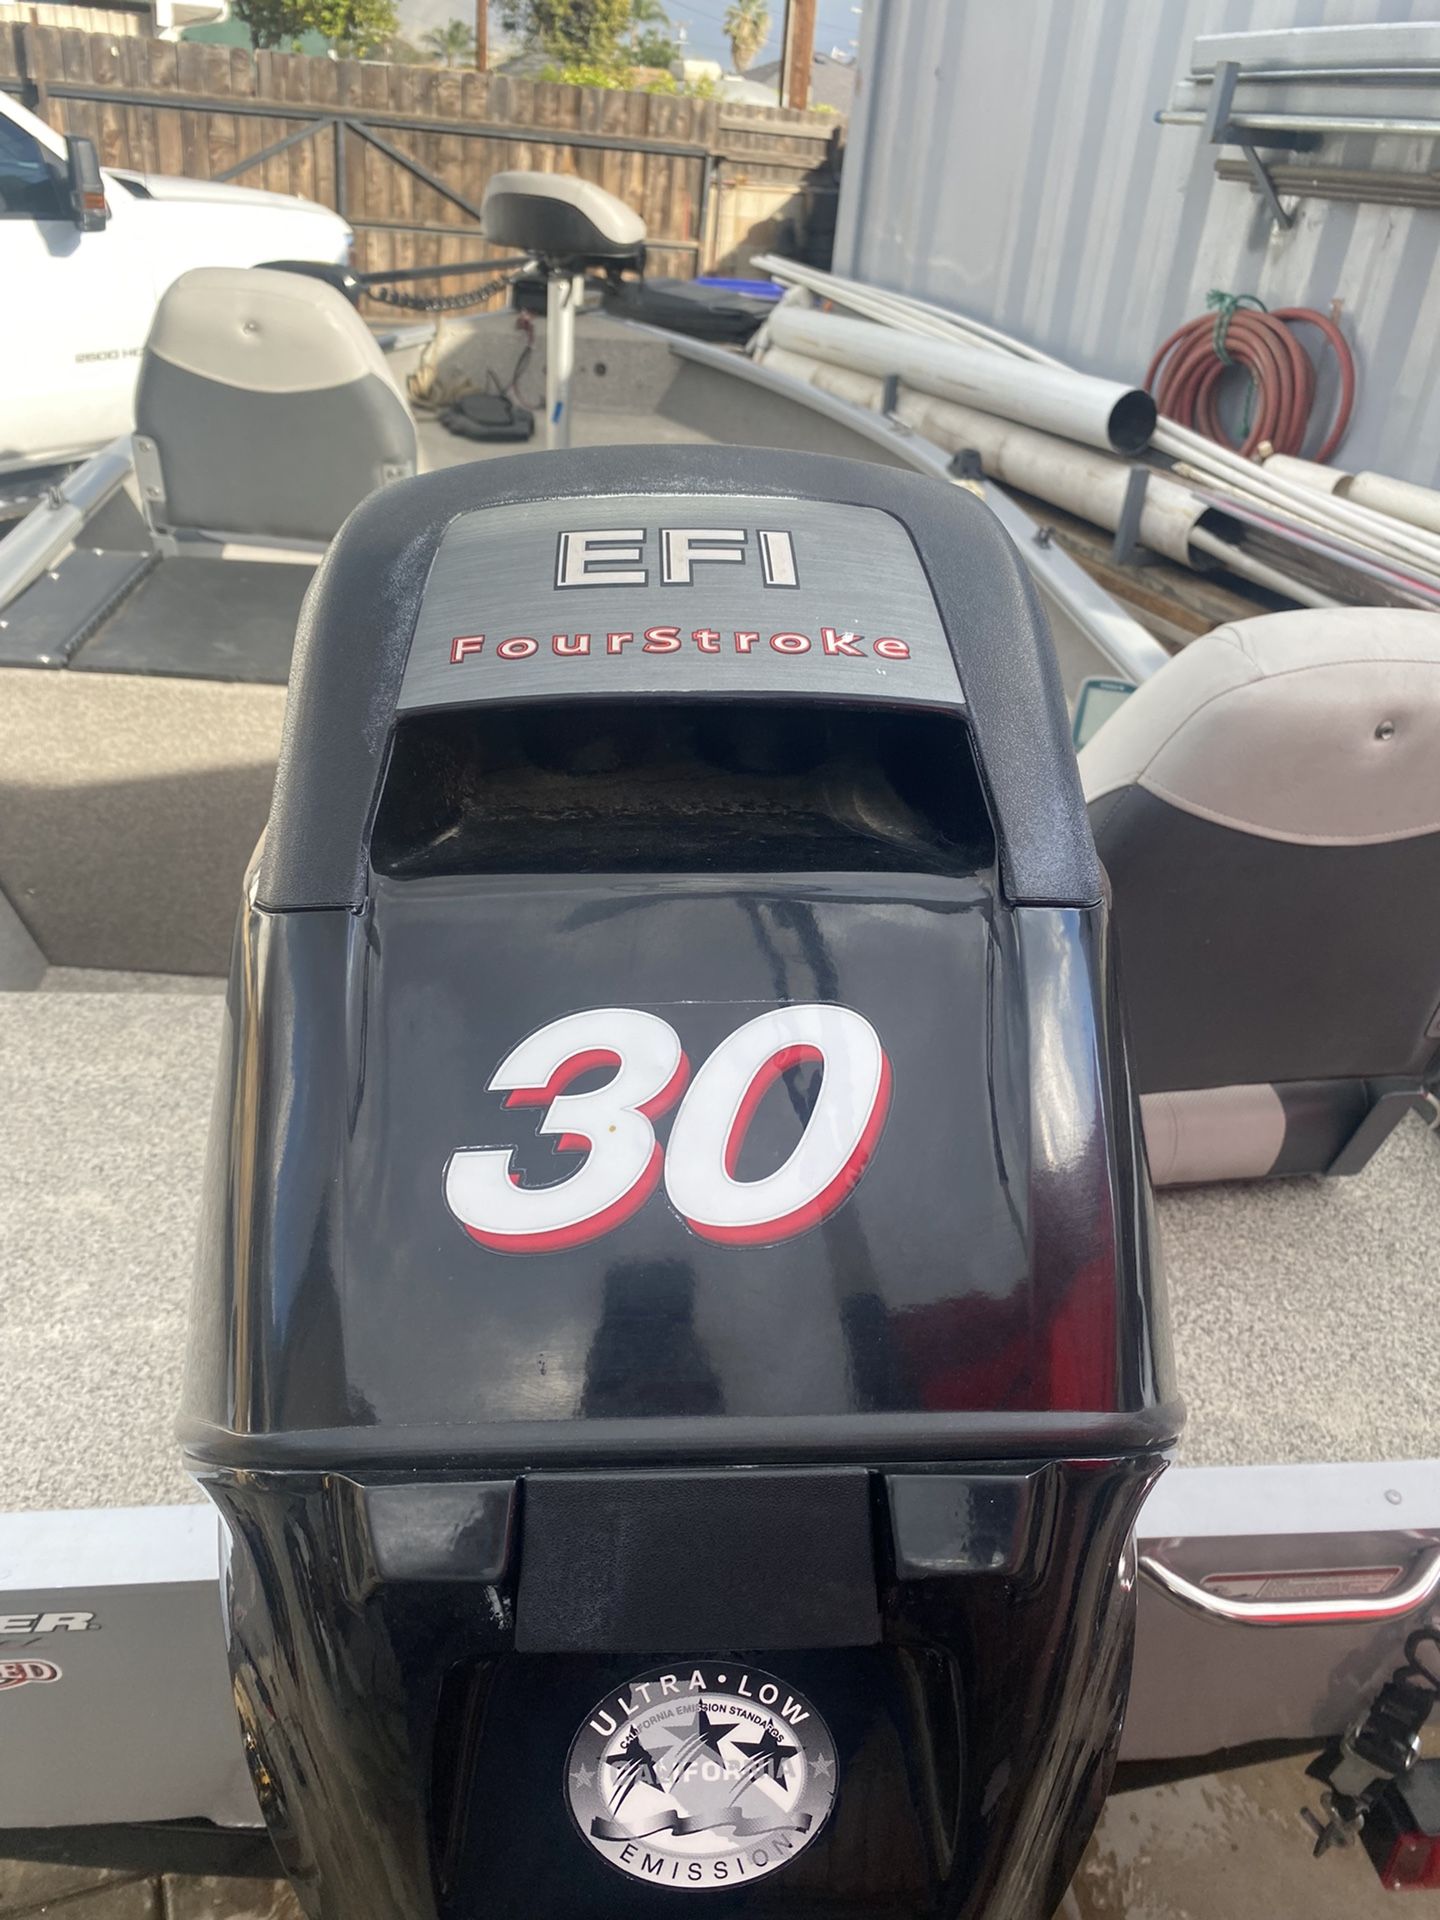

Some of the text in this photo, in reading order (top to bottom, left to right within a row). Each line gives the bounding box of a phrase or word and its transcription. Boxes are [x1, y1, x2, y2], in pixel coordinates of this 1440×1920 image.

[553, 527, 800, 590] EFI
[450, 625, 913, 664] FourStroke
[445, 1003, 893, 1254] 30
[676, 1702, 728, 1718] EMISSION
[619, 1833, 794, 1882] EMISSION
